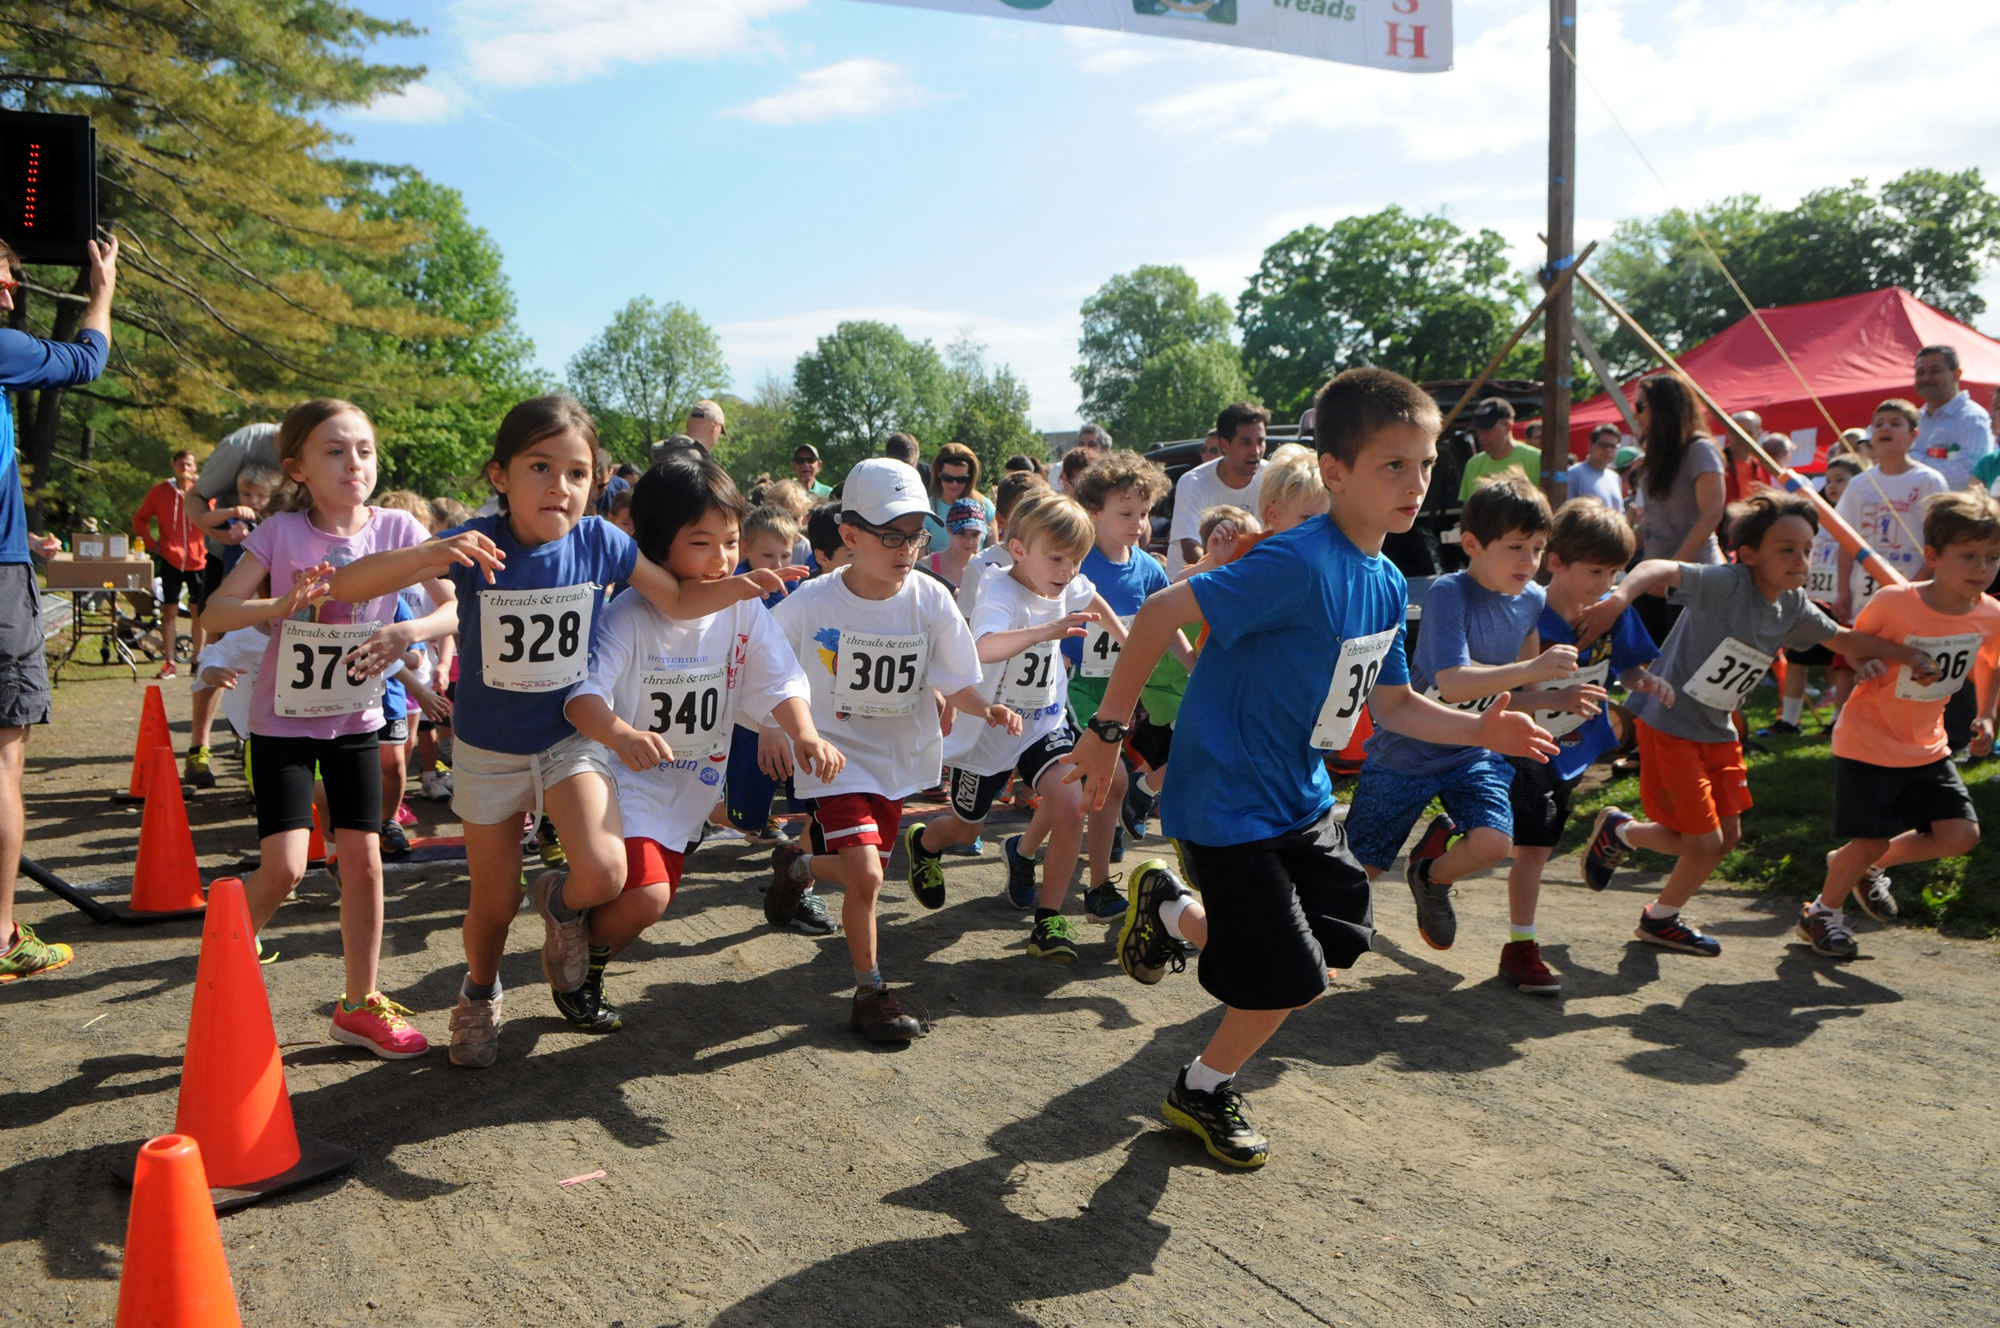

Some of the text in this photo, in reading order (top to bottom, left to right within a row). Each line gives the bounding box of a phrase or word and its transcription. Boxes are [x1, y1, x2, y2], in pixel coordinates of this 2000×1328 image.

[1811, 573, 1833, 592] 321
[490, 588, 588, 607] threads & treads
[286, 625, 376, 639] threads & treads
[498, 610, 581, 663] 328
[846, 636, 883, 648] threads
[885, 640, 897, 649] &
[898, 637, 924, 648] treads
[643, 668, 725, 685] threads & treads
[849, 651, 918, 694] 305
[1016, 652, 1054, 688] 31
[1706, 655, 1763, 694] 376
[648, 687, 719, 735] 340
